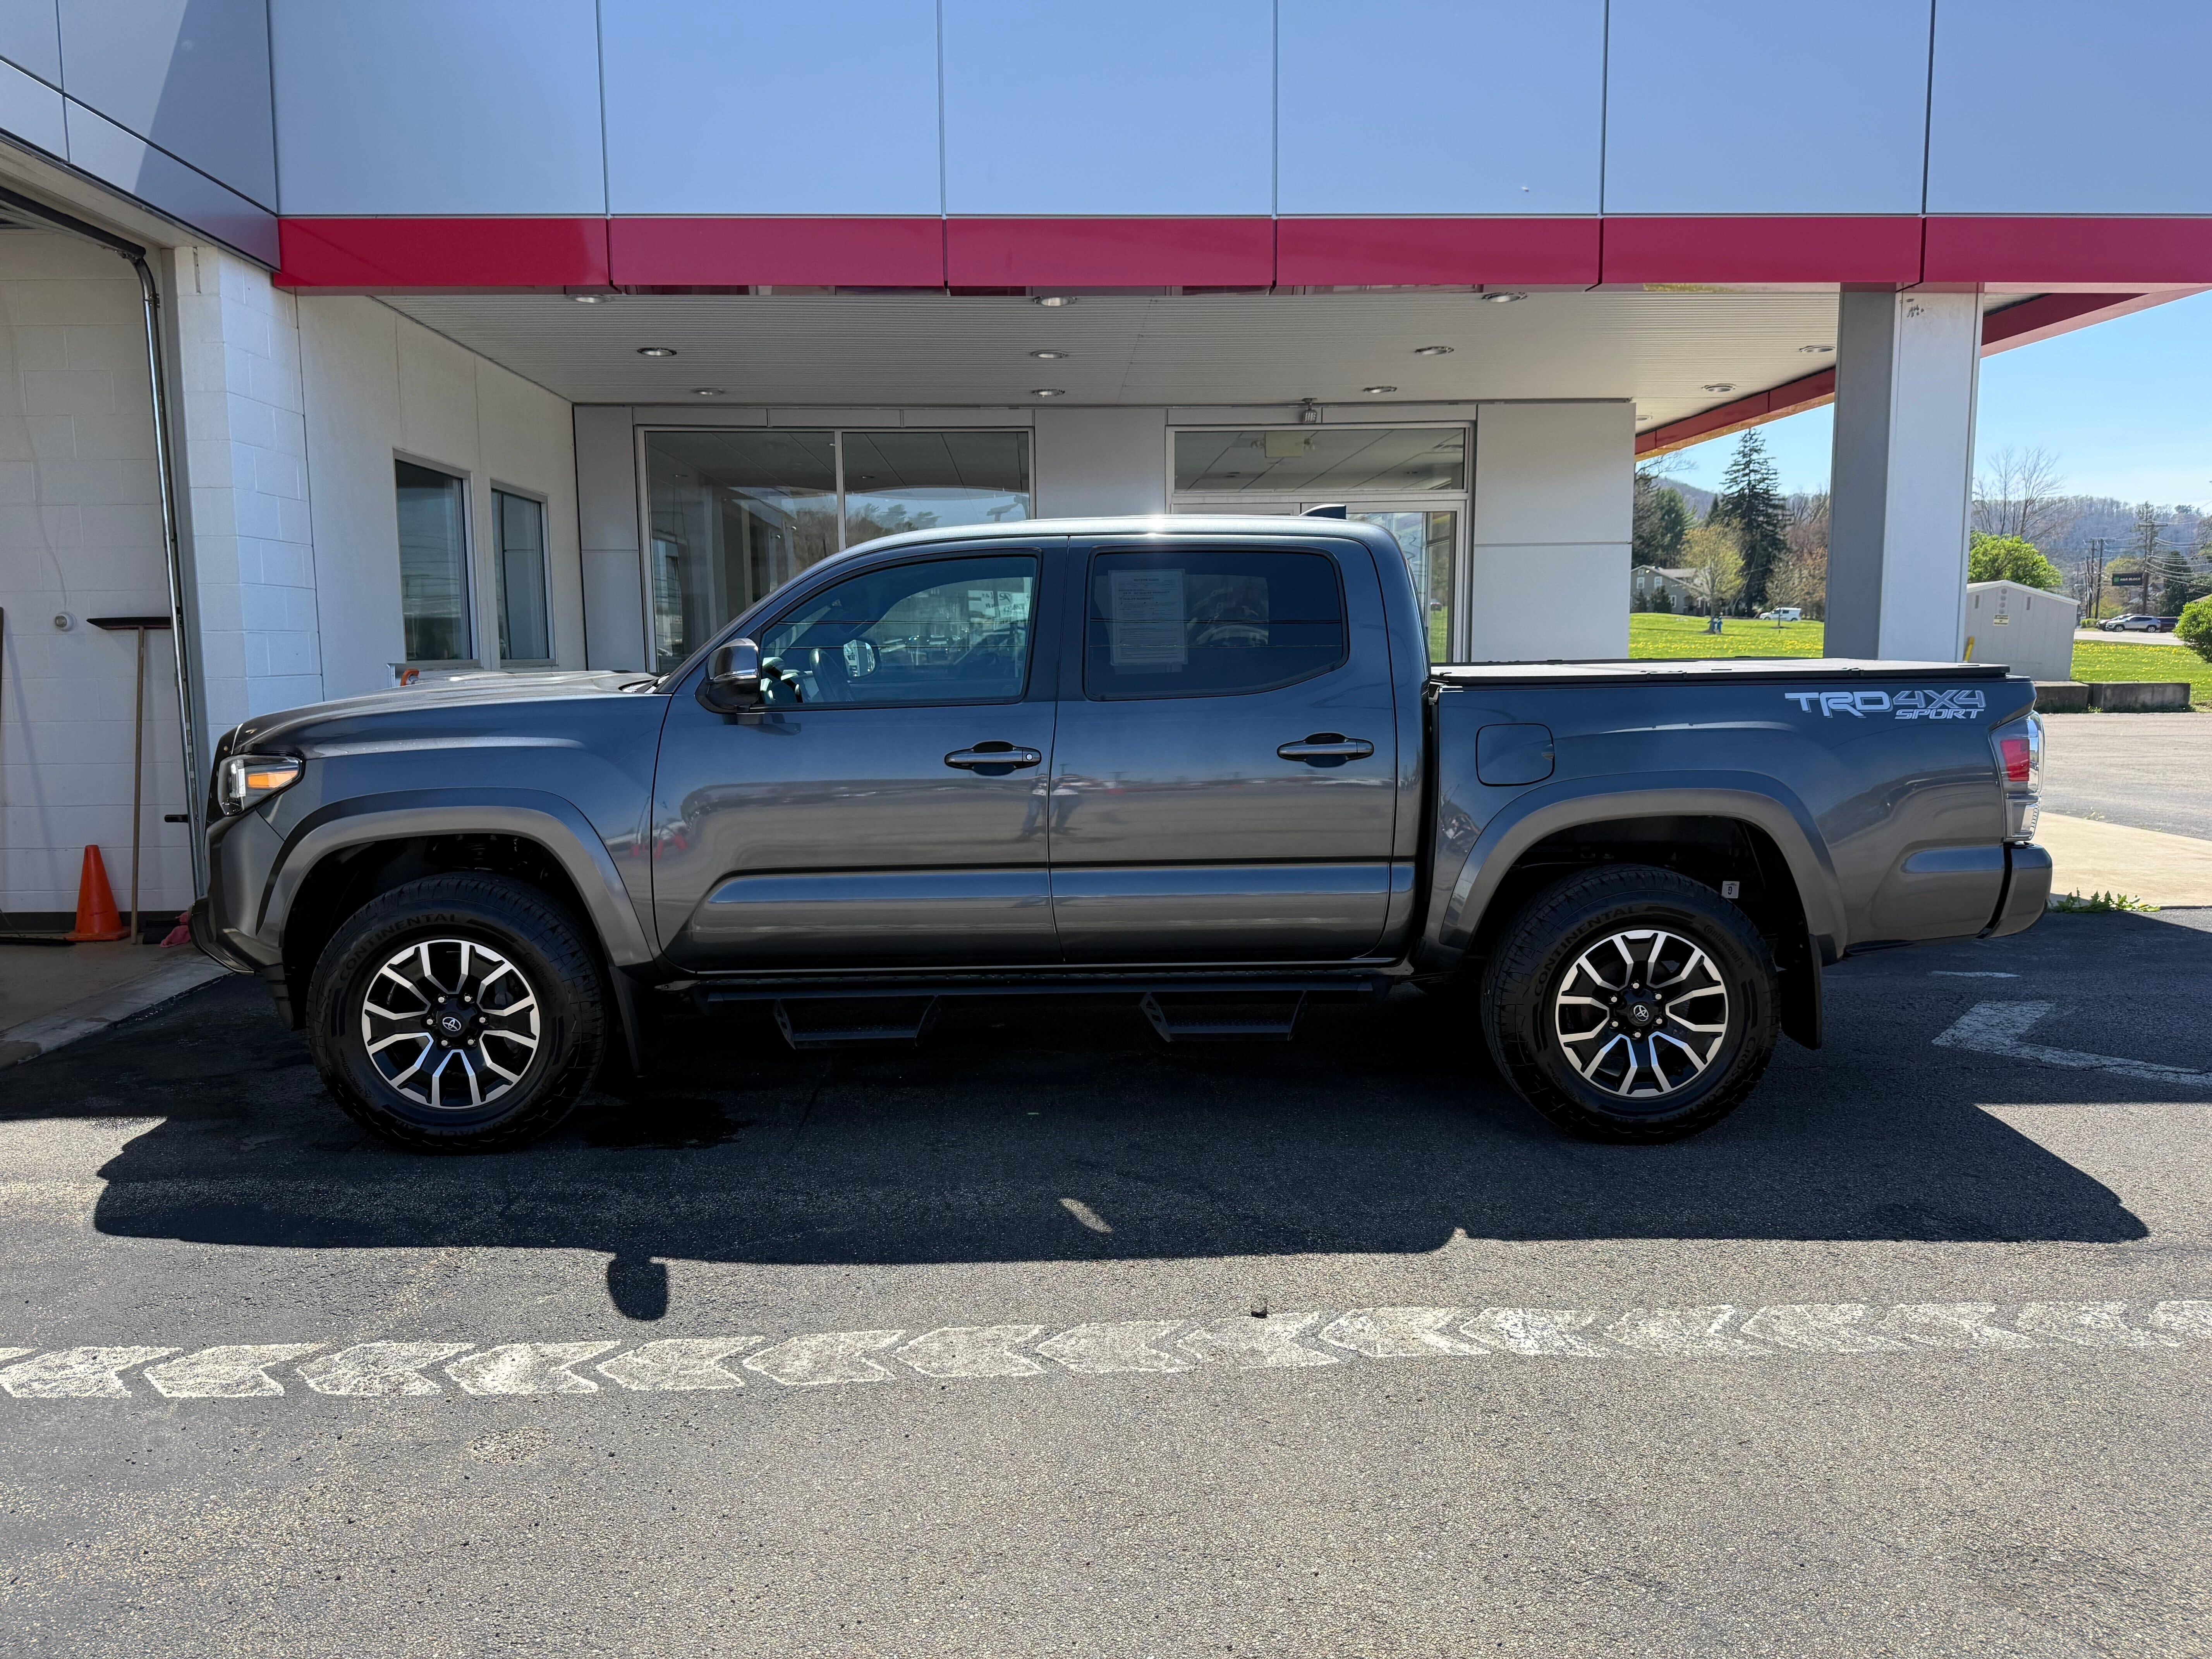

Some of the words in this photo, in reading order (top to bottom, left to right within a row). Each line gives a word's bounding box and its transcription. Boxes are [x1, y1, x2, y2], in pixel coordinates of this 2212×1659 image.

[1784, 691, 1893, 718] TRD
[1895, 708, 1984, 719] SPORT
[339, 914, 456, 982] CONTINENTAL
[1535, 907, 1637, 996] CONTINENTAL
